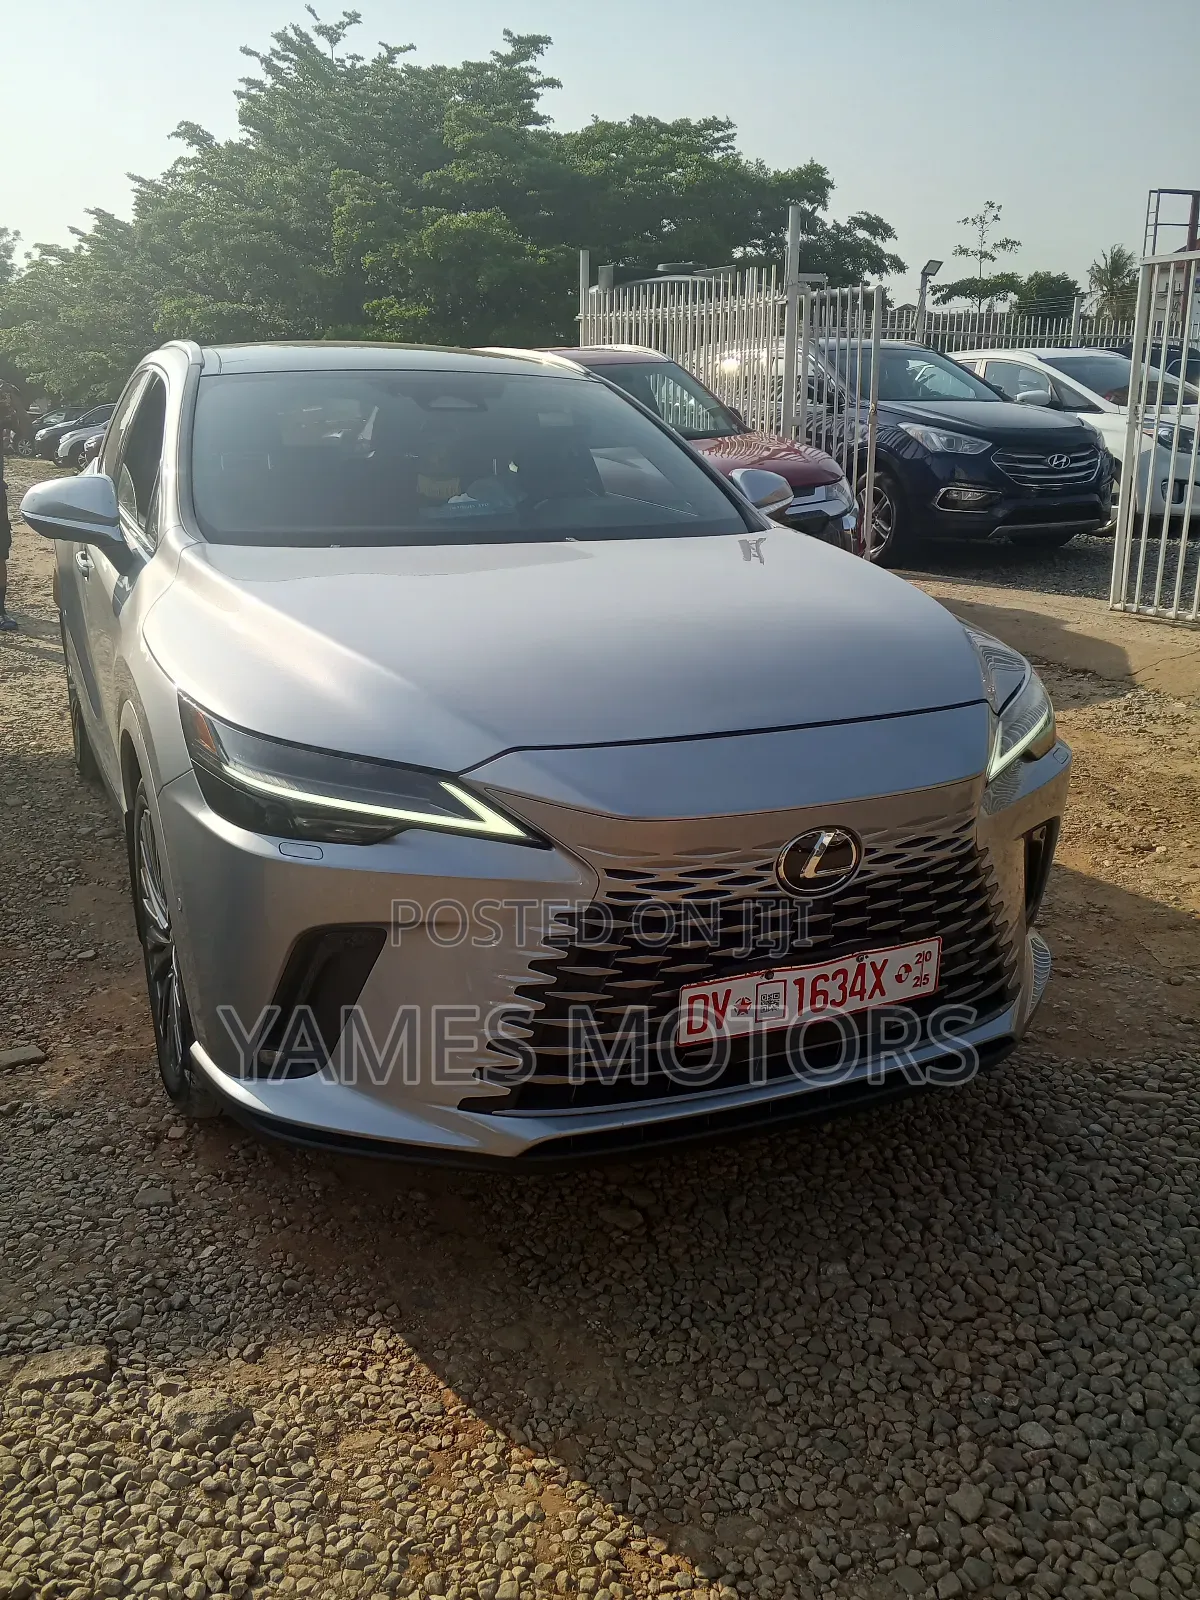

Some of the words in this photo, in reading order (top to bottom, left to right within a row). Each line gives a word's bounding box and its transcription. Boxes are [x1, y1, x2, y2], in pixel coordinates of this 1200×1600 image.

[914, 950, 932, 965] 20
[912, 974, 930, 988] 25
[686, 988, 732, 1035] DV
[792, 958, 889, 1017] 1634X
